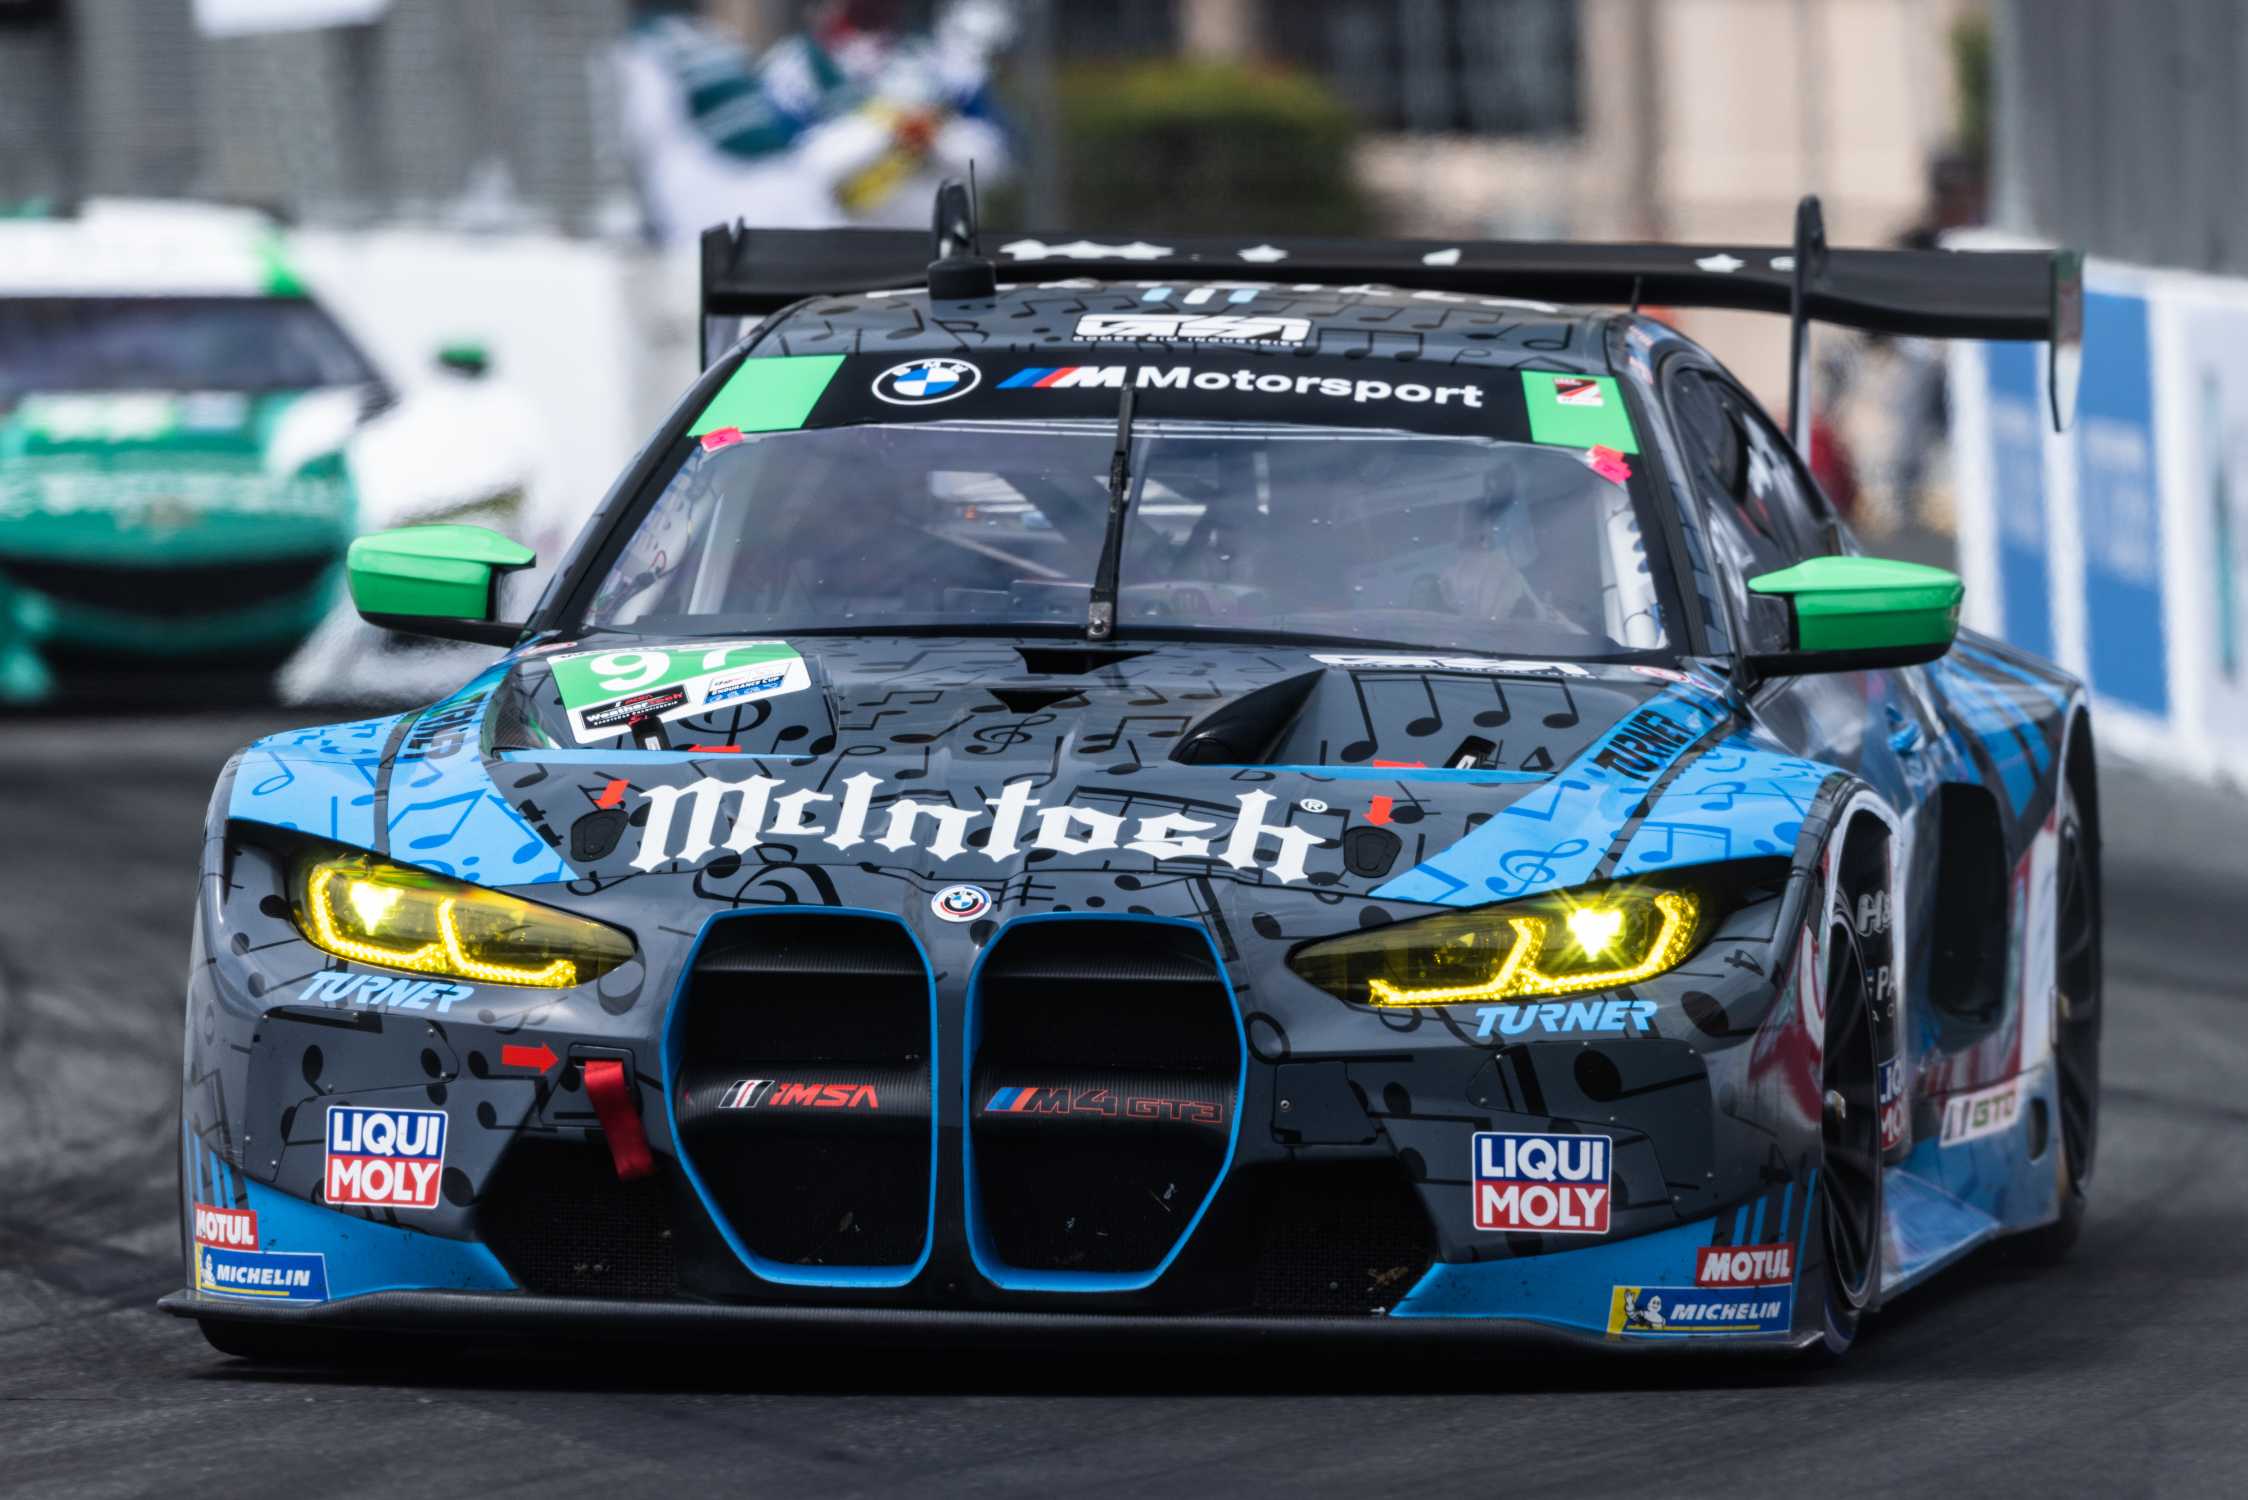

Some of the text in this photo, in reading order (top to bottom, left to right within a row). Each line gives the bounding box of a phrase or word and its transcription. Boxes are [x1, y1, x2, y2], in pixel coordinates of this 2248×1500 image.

[1134, 365, 1484, 408] Motorsport
[589, 645, 753, 692] 97
[1594, 709, 1697, 782] TURNER
[628, 771, 1326, 884] McIntosh
[297, 969, 475, 1013] TURNER
[1474, 1000, 1659, 1038] TURNER
[1125, 1096, 1223, 1124] GT3
[332, 1111, 440, 1158] LIQUI
[331, 1158, 440, 1203] MOLY
[1480, 1137, 1604, 1183] LIQUI
[195, 1208, 255, 1246] MOTUL
[1481, 1184, 1607, 1228] MOLY
[215, 1263, 311, 1287] MICHELIN
[1700, 1248, 1791, 1282] MOTUL
[1669, 1300, 1780, 1321] MICHELIN
